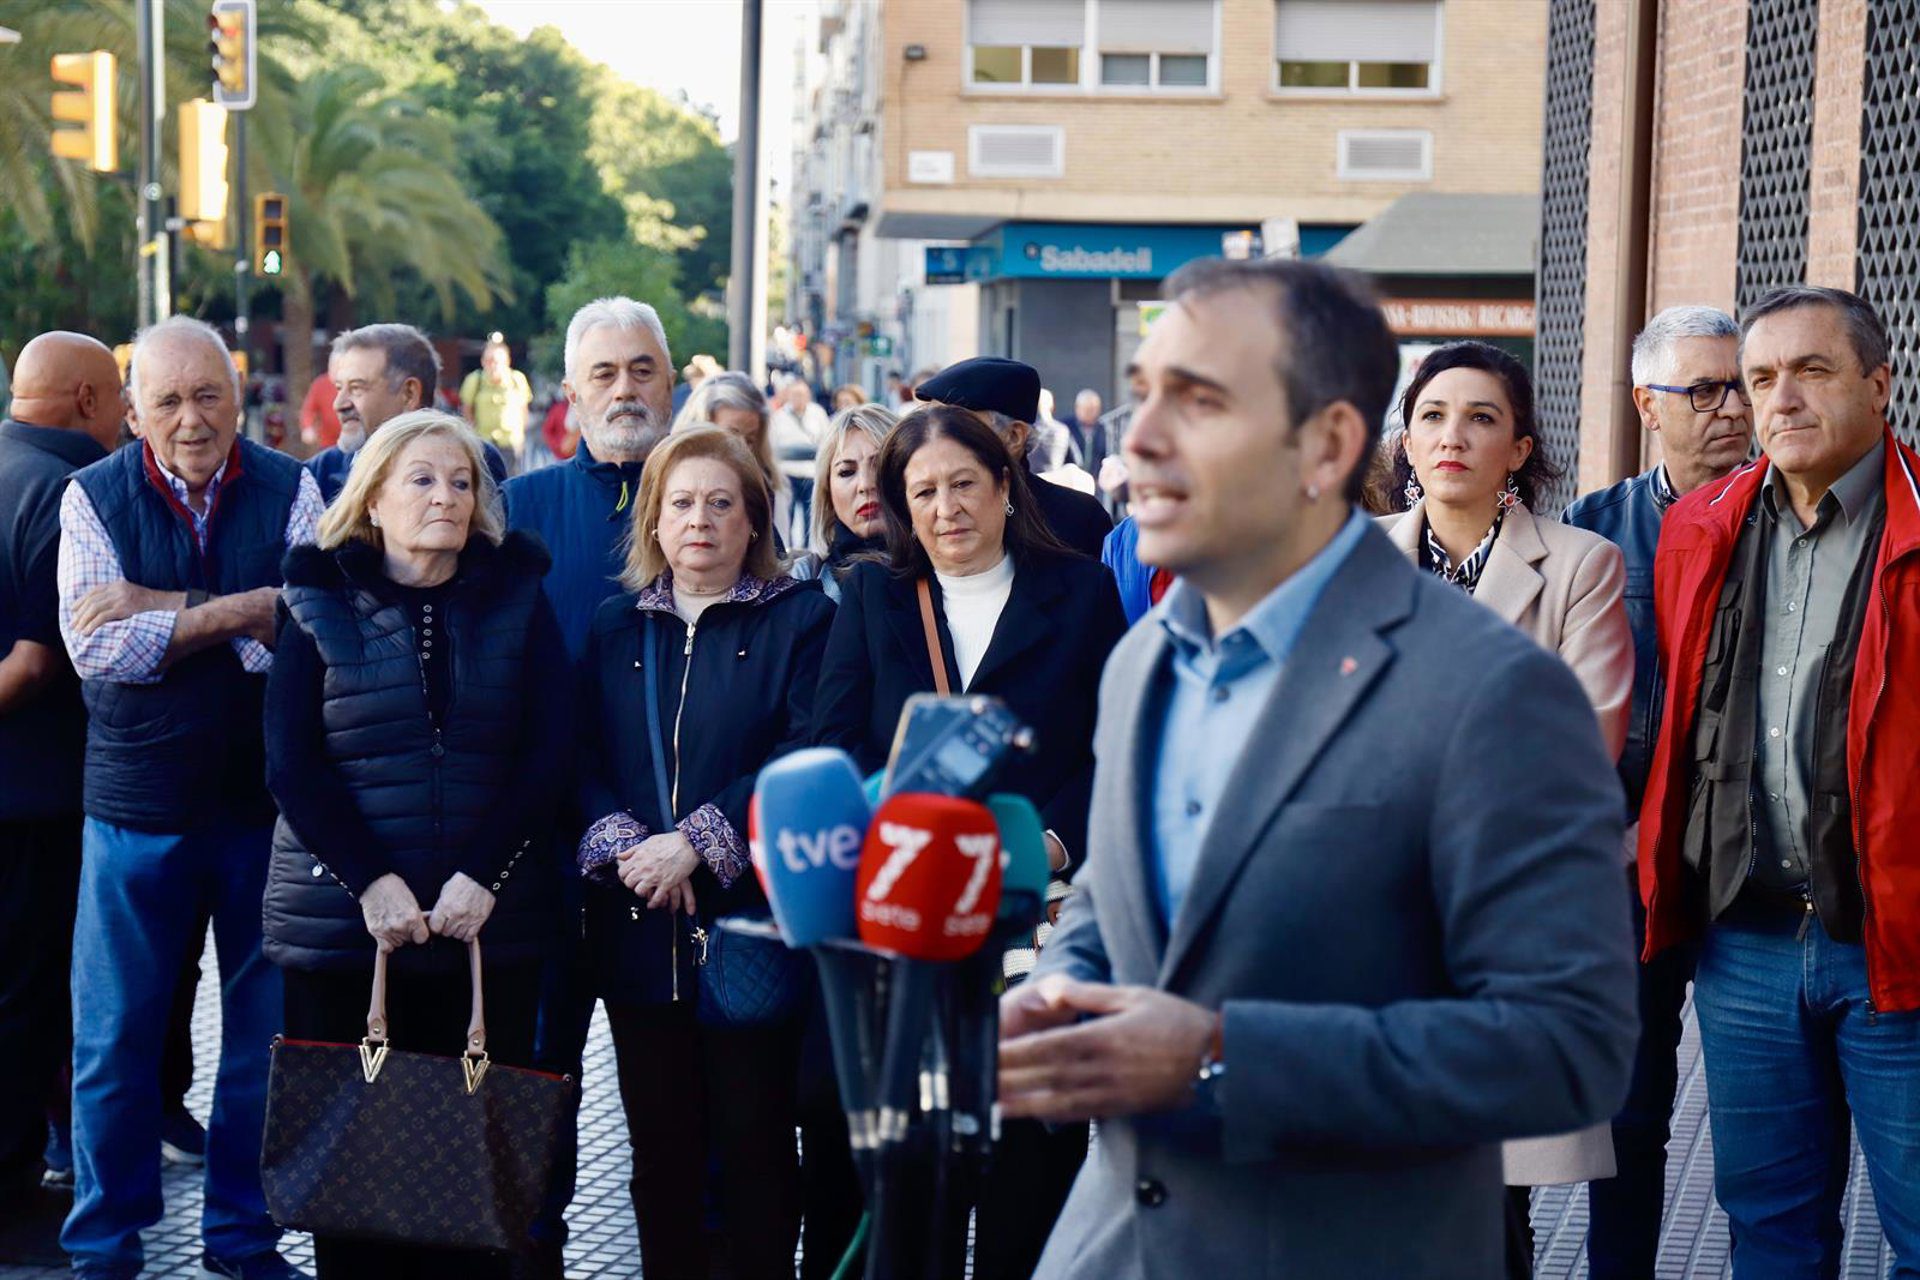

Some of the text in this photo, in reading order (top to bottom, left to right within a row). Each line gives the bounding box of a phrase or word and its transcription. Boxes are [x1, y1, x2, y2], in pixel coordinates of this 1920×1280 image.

[1040, 246, 1152, 272] Sabadell
[777, 824, 859, 873] tve
[866, 821, 933, 901] 7
[954, 834, 996, 914] 7
